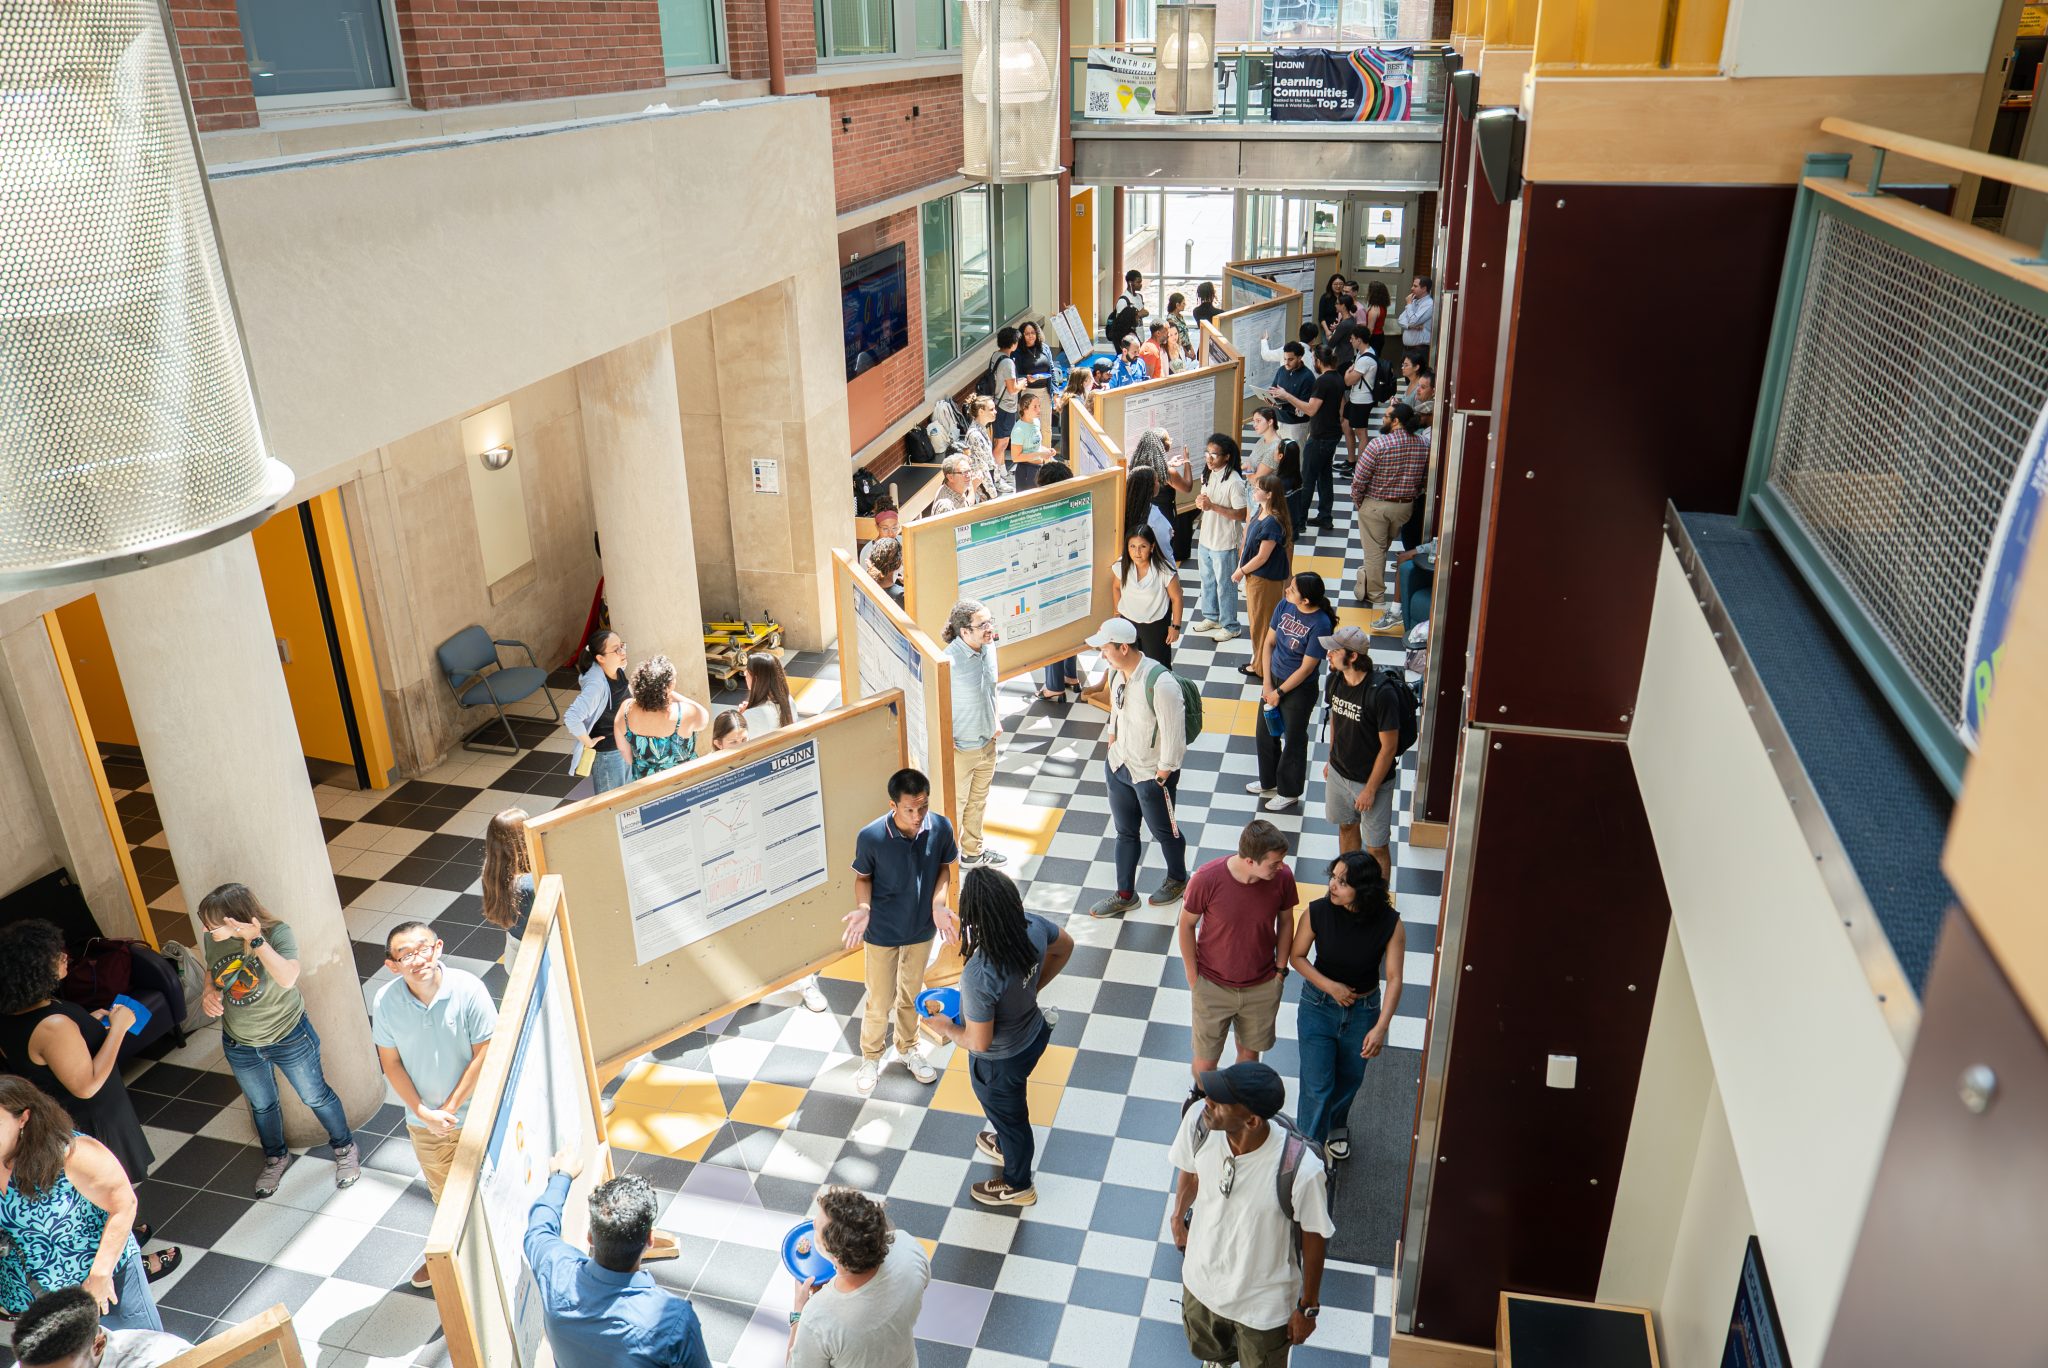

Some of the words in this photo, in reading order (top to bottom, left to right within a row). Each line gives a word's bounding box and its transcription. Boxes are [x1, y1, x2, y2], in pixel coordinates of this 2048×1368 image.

[1110, 55, 1138, 67] MONTH
[1274, 61, 1304, 69] UCONN
[1274, 76, 1324, 88] Learning
[1274, 87, 1348, 98] Communities
[1317, 98, 1338, 110] Top
[1340, 98, 1354, 108] 25
[1278, 612, 1310, 638] Twins
[1332, 702, 1360, 722] RGANIC
[770, 746, 813, 772] UCONN
[623, 810, 638, 818] TRIO
